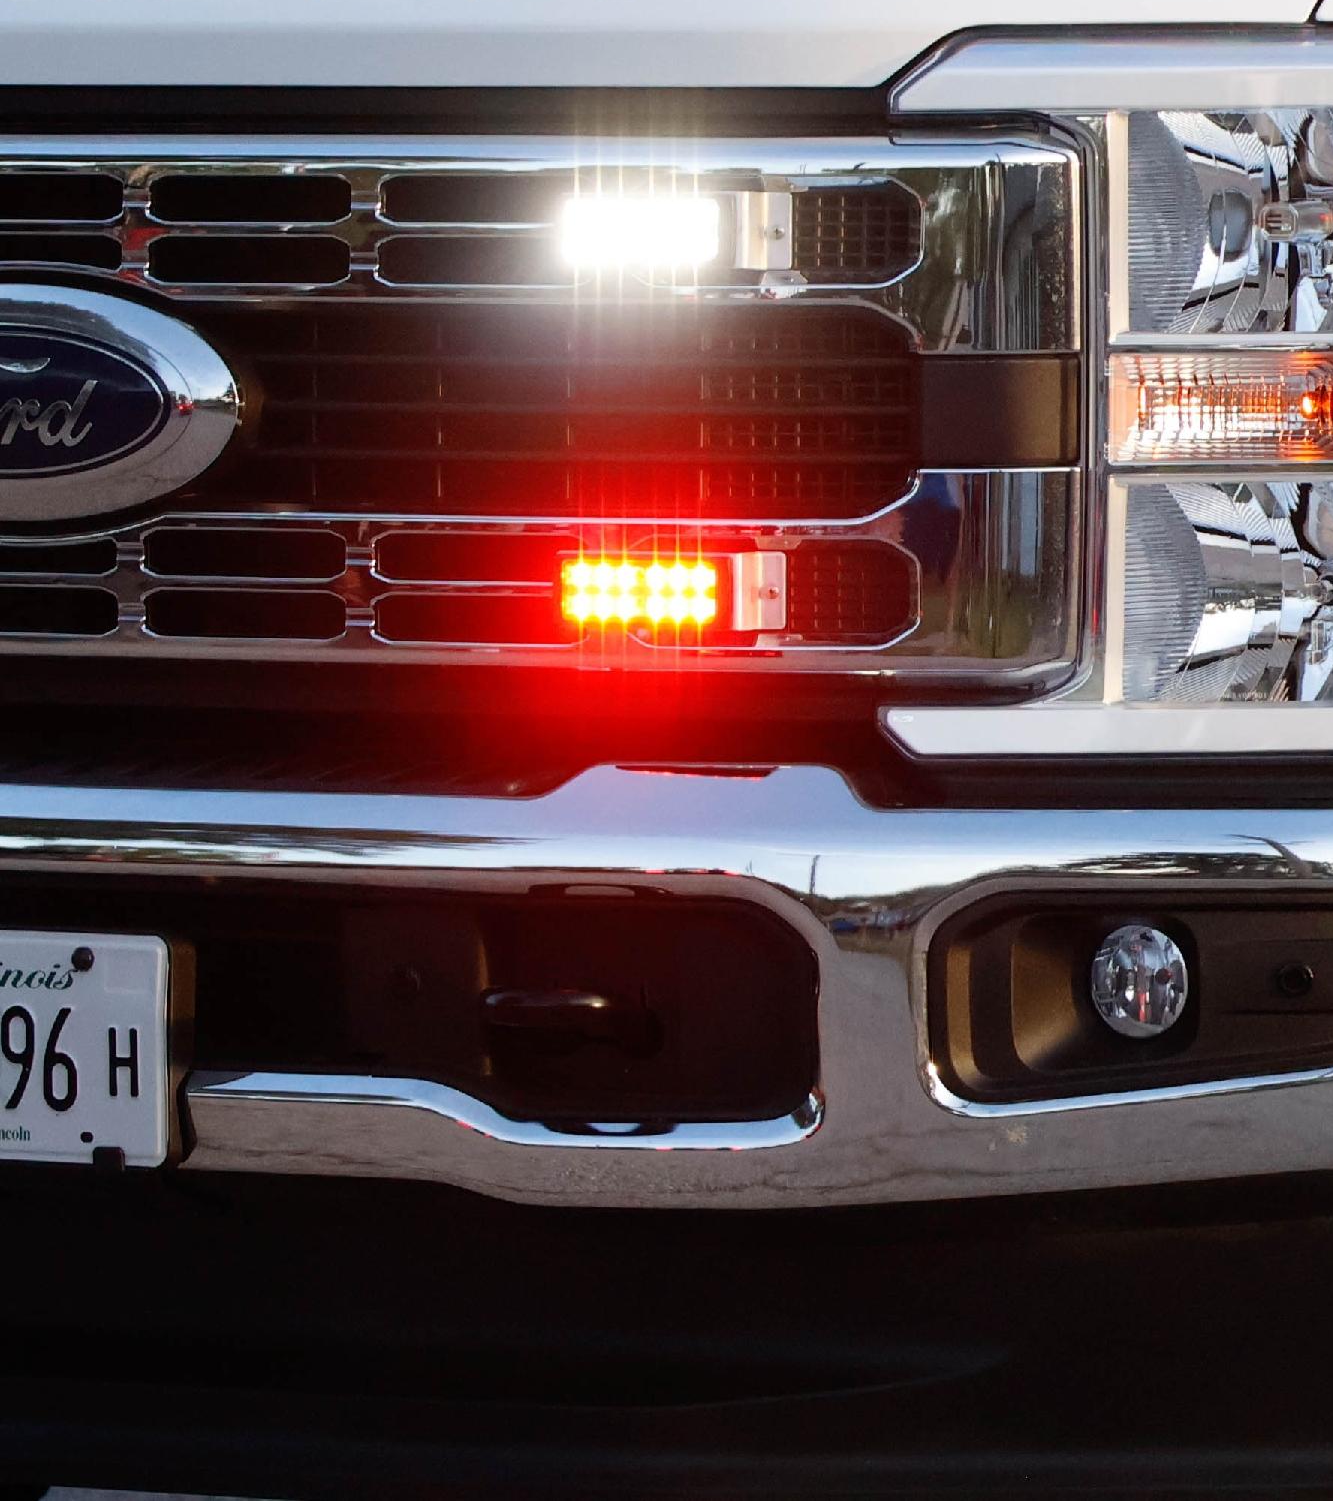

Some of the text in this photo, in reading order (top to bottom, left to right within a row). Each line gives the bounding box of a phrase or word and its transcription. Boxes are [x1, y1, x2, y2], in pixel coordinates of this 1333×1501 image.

[0, 962, 79, 990] nois
[0, 1005, 139, 1112] 96 H
